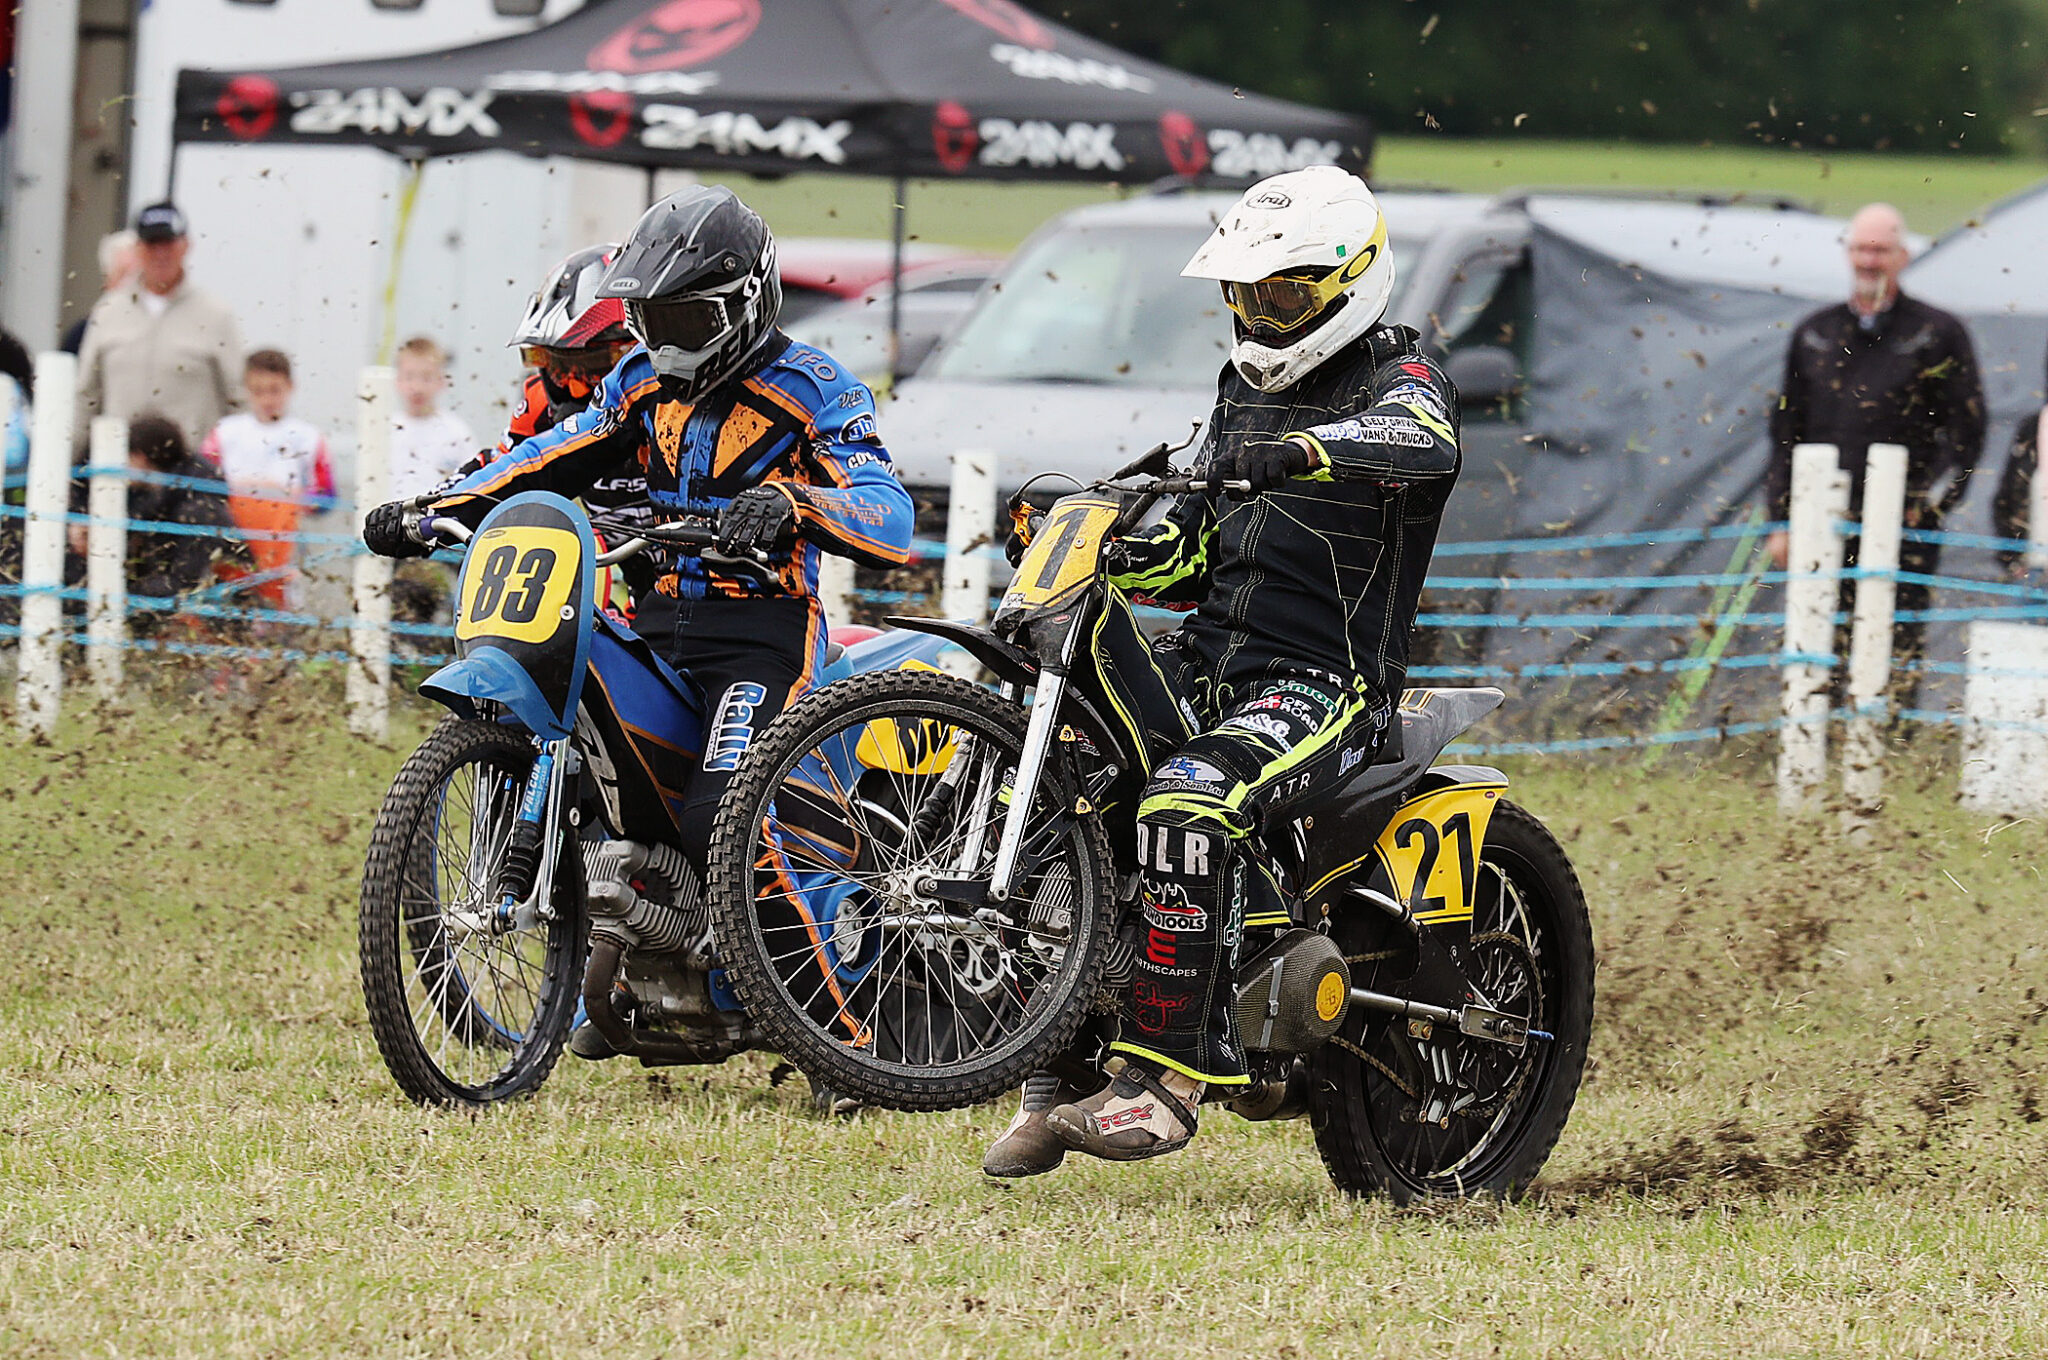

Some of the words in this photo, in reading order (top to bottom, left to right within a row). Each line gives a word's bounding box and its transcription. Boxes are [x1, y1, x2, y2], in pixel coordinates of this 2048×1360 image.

[290, 88, 500, 138] 24MX
[641, 103, 851, 165] 24MX
[1361, 429, 1386, 441] VANS
[1396, 431, 1433, 446] TRUCKS
[469, 545, 557, 623] 83
[1279, 702, 1318, 733] ROAD
[1283, 696, 1312, 712] OFF
[1394, 812, 1475, 913] 21
[1135, 954, 1198, 977] ARTHSCAPES
